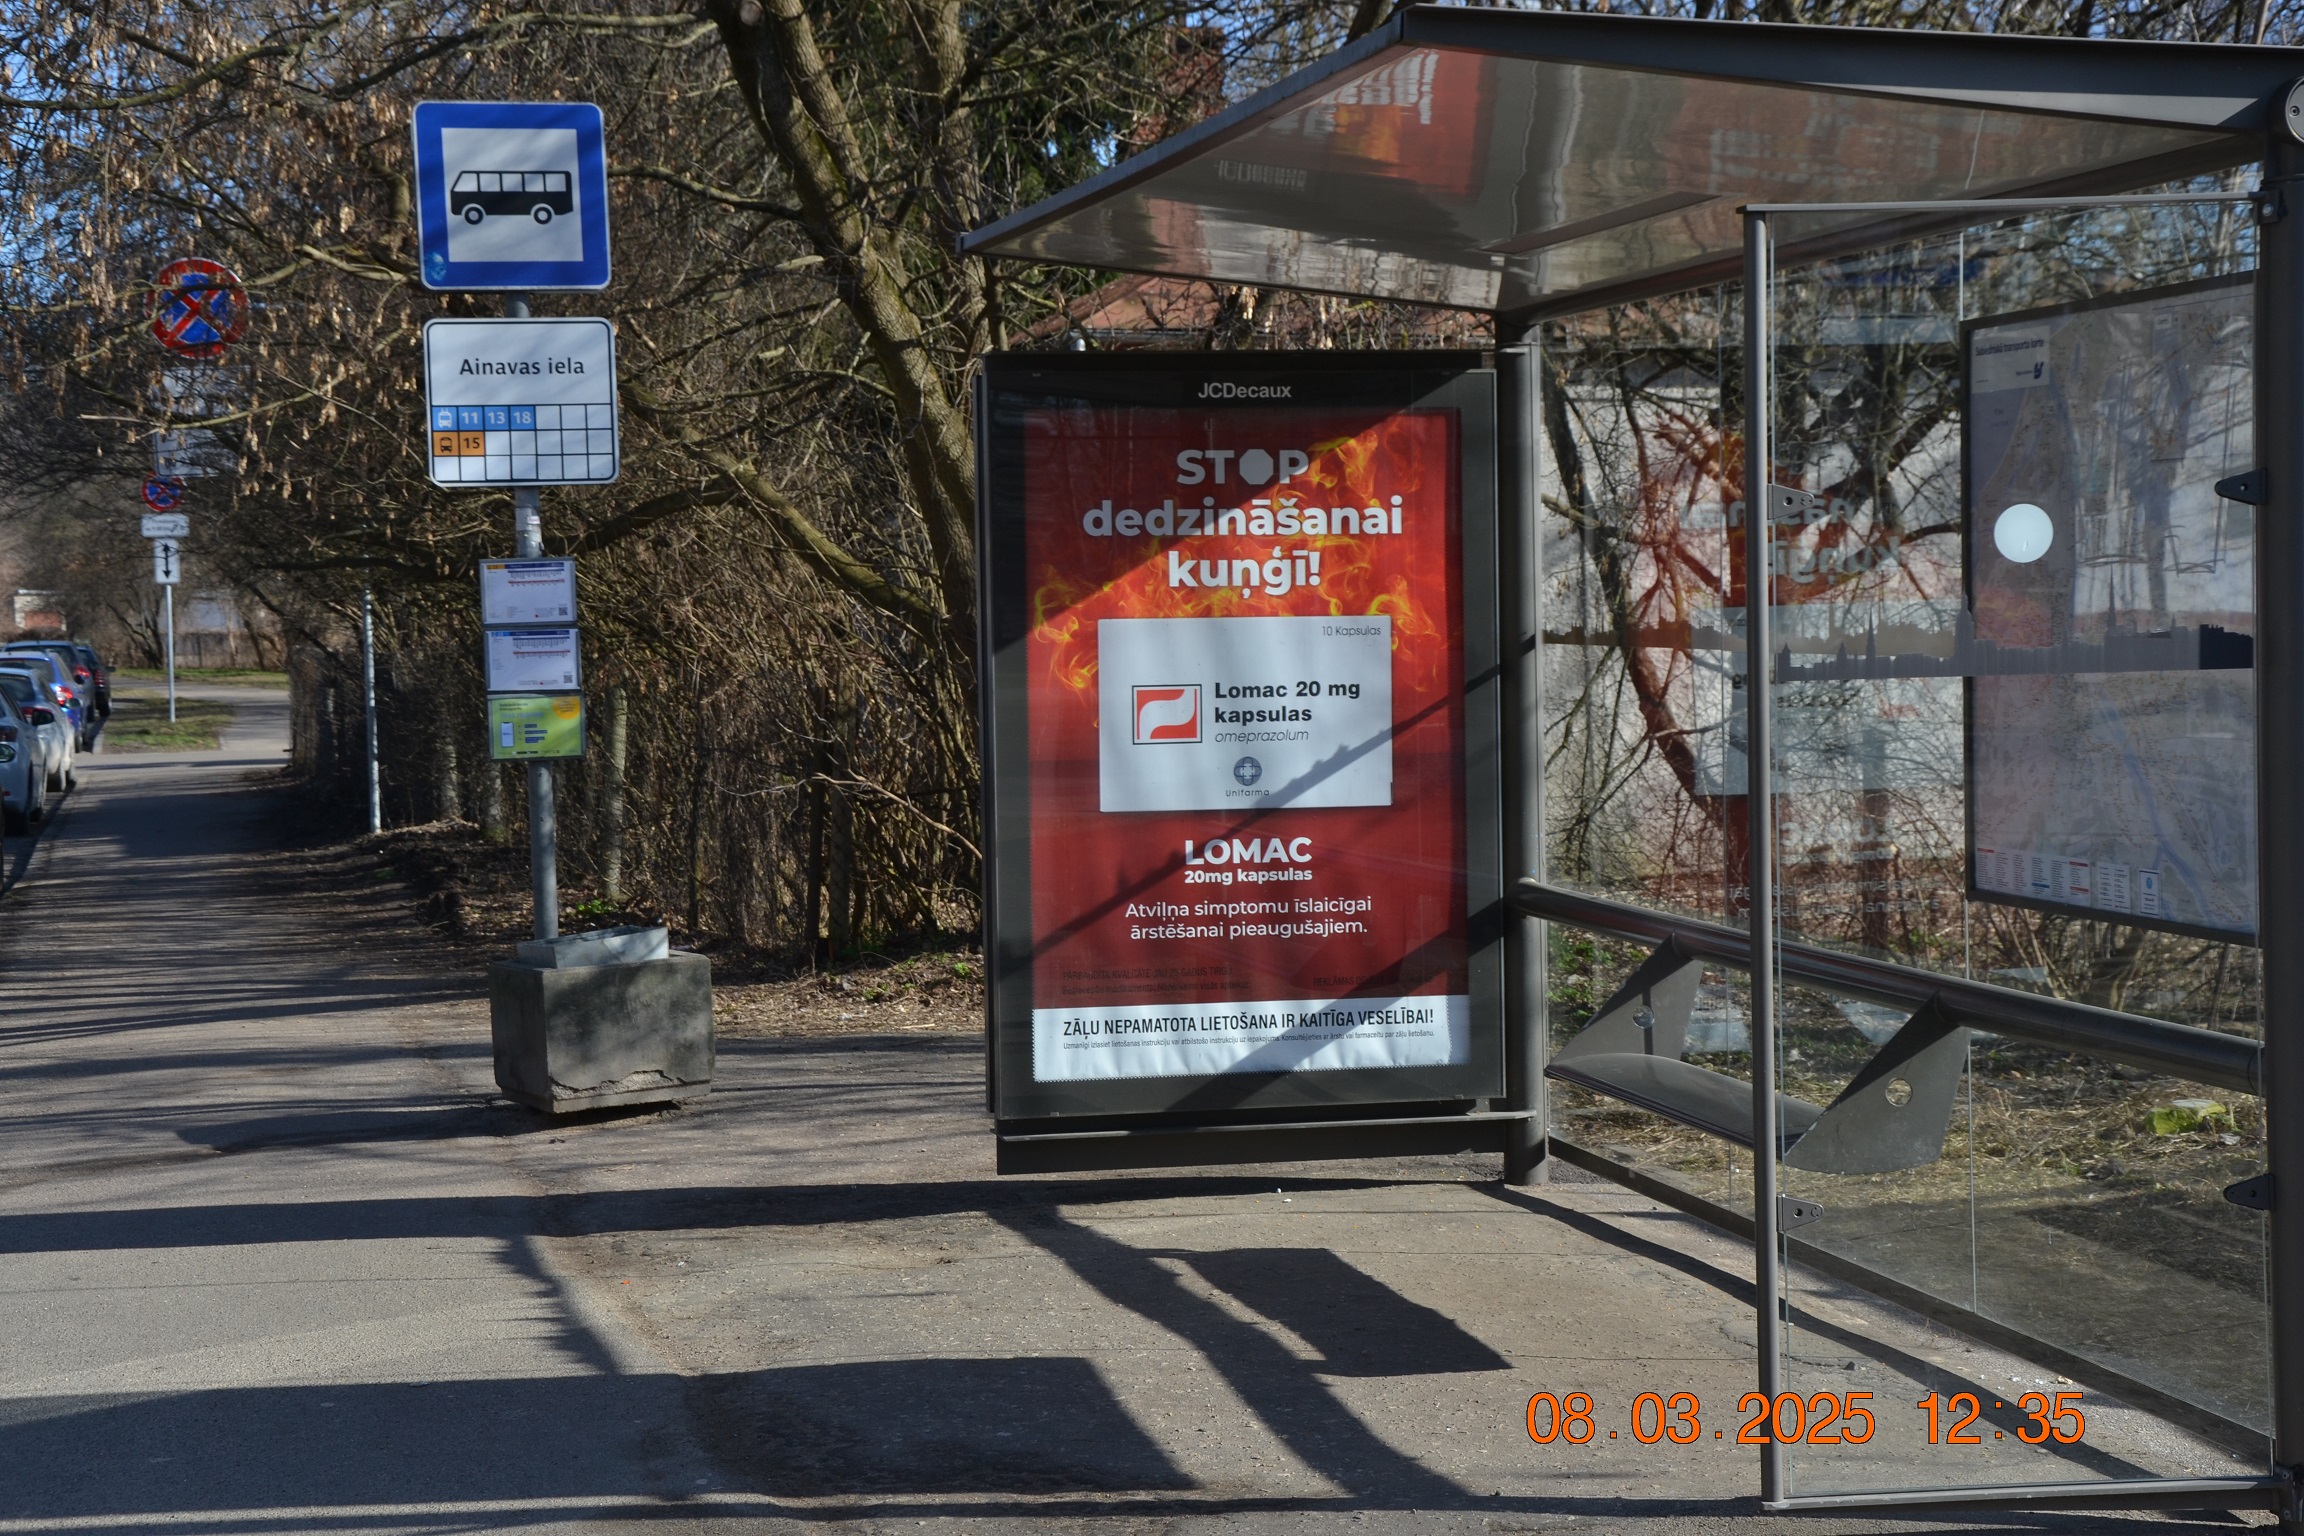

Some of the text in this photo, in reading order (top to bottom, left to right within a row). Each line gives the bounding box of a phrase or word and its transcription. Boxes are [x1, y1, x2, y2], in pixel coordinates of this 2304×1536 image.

[459, 357, 585, 376] Ainavas iela
[1197, 382, 1292, 399] JCDecaux
[461, 411, 531, 424] 11 13 18
[463, 436, 480, 449] 15
[1082, 494, 1403, 536] dedzināšanai
[1167, 546, 1322, 599] kuņģī!
[1322, 625, 1382, 638] 10 Kapsulas
[1214, 680, 1361, 699] Lomac 20 mg
[1214, 705, 1312, 726] kapsulas
[1214, 728, 1310, 745] omeprazolum
[1184, 836, 1313, 866] LOMAC
[1184, 868, 1313, 886] 20mg kapsulas
[1125, 895, 1372, 924] Atviļņa simptomu īslaicīgai
[1130, 918, 1368, 941] ārstēšanai pieaugušajiem.
[1064, 1006, 1434, 1040] ZĀĻU NEPAMATOTA LIETOŠANA IR KAITĪGA VESELĪBAI!
